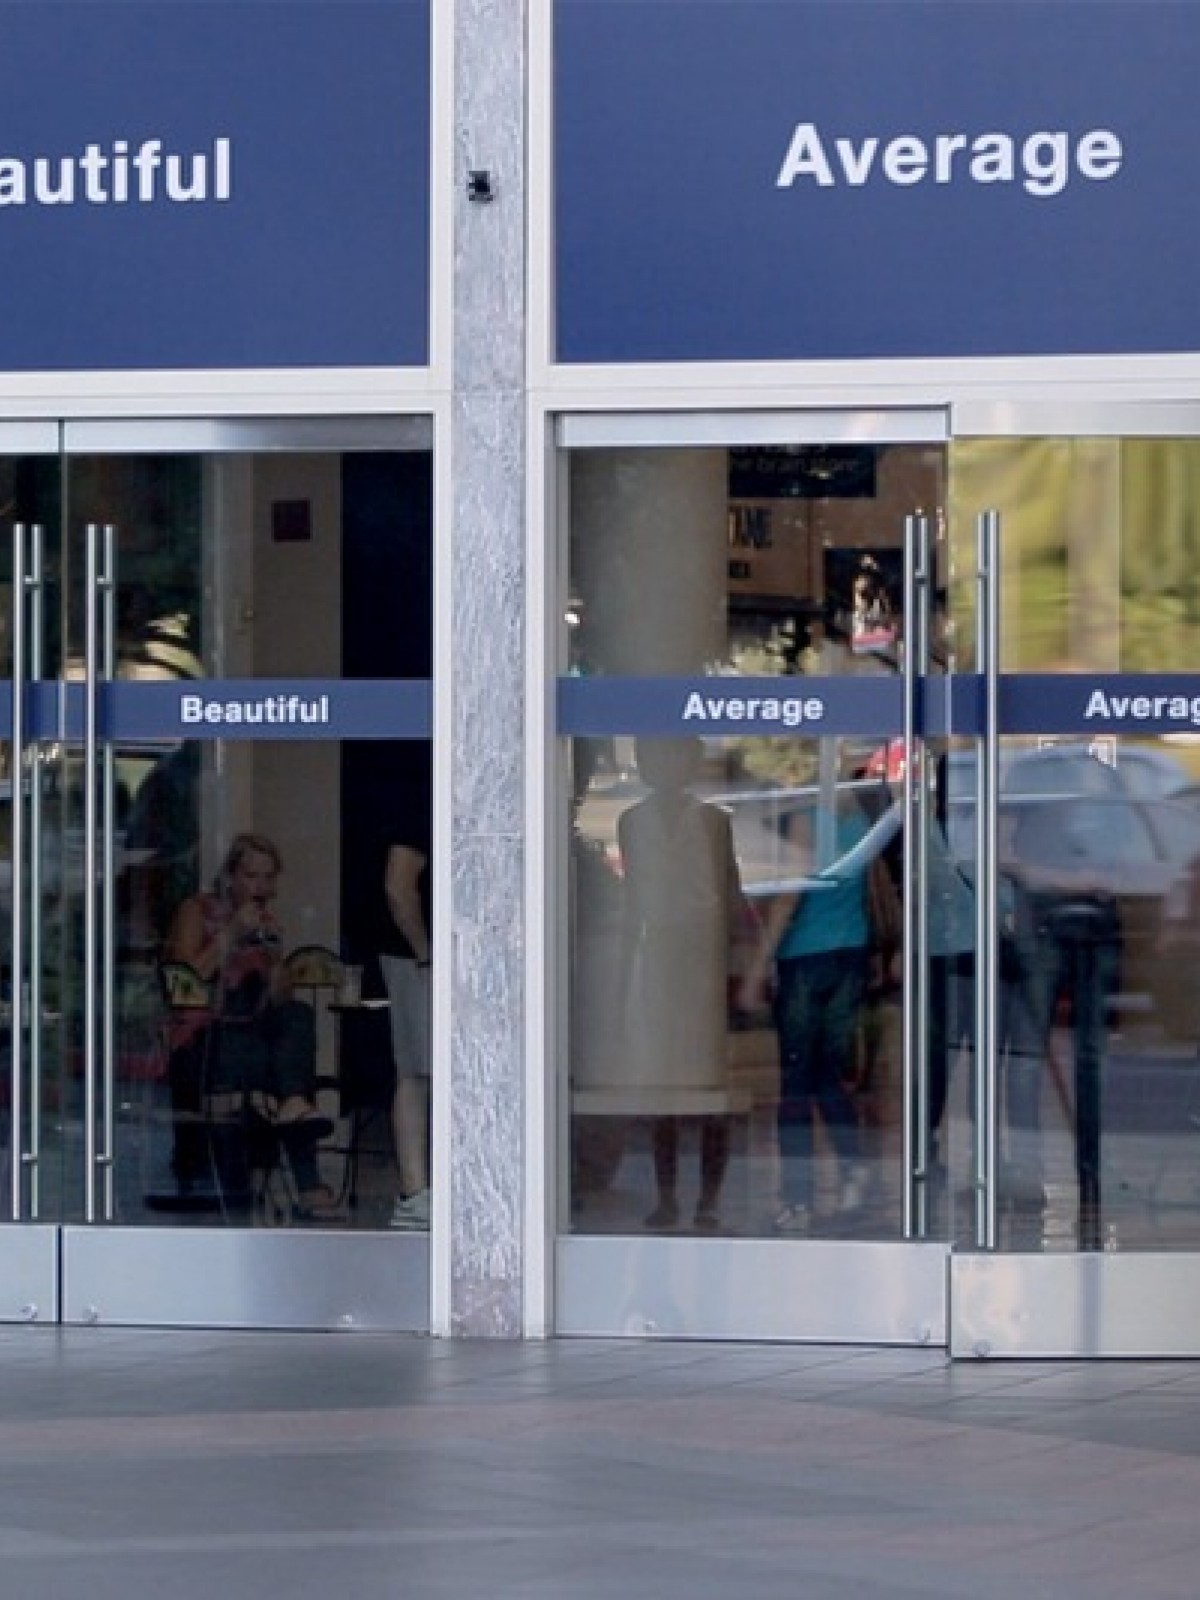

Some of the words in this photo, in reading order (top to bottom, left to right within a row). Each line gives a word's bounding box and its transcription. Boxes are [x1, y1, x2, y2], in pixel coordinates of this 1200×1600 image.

[776, 122, 1123, 197] Average
[180, 695, 329, 723] Beautiful
[681, 690, 824, 726] Average
